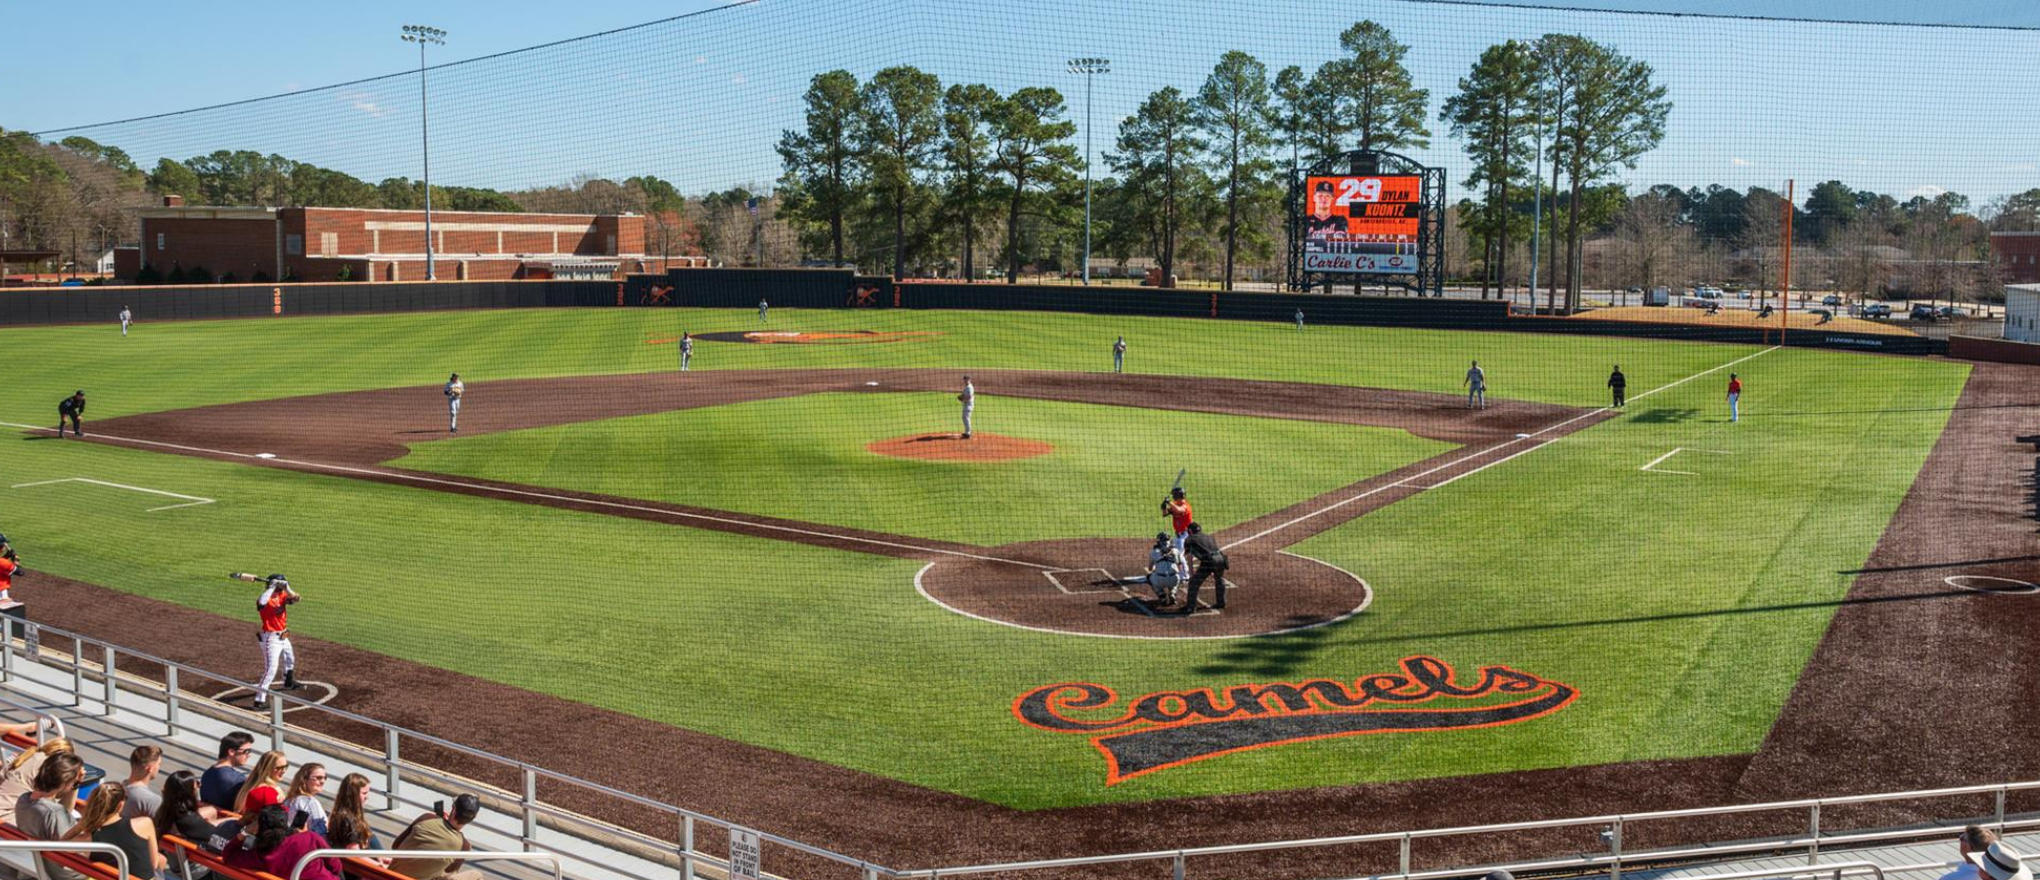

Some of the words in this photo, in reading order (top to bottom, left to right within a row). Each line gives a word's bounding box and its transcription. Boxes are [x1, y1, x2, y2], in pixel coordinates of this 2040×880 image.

[1335, 179, 1382, 206] 29
[1381, 191, 1410, 201] DYLAN
[1365, 203, 1407, 217] KOONTZ
[1307, 255, 1351, 269] Carlie
[1355, 256, 1375, 270] C's
[1011, 655, 1550, 734] Camels
[732, 841, 749, 852] PLEASE
[750, 846, 757, 854] DO
[732, 850, 741, 858] NOT
[742, 852, 757, 862] STAND
[740, 860, 756, 869] FRONT
[733, 865, 741, 873] OF
[742, 867, 756, 878] RAIL
